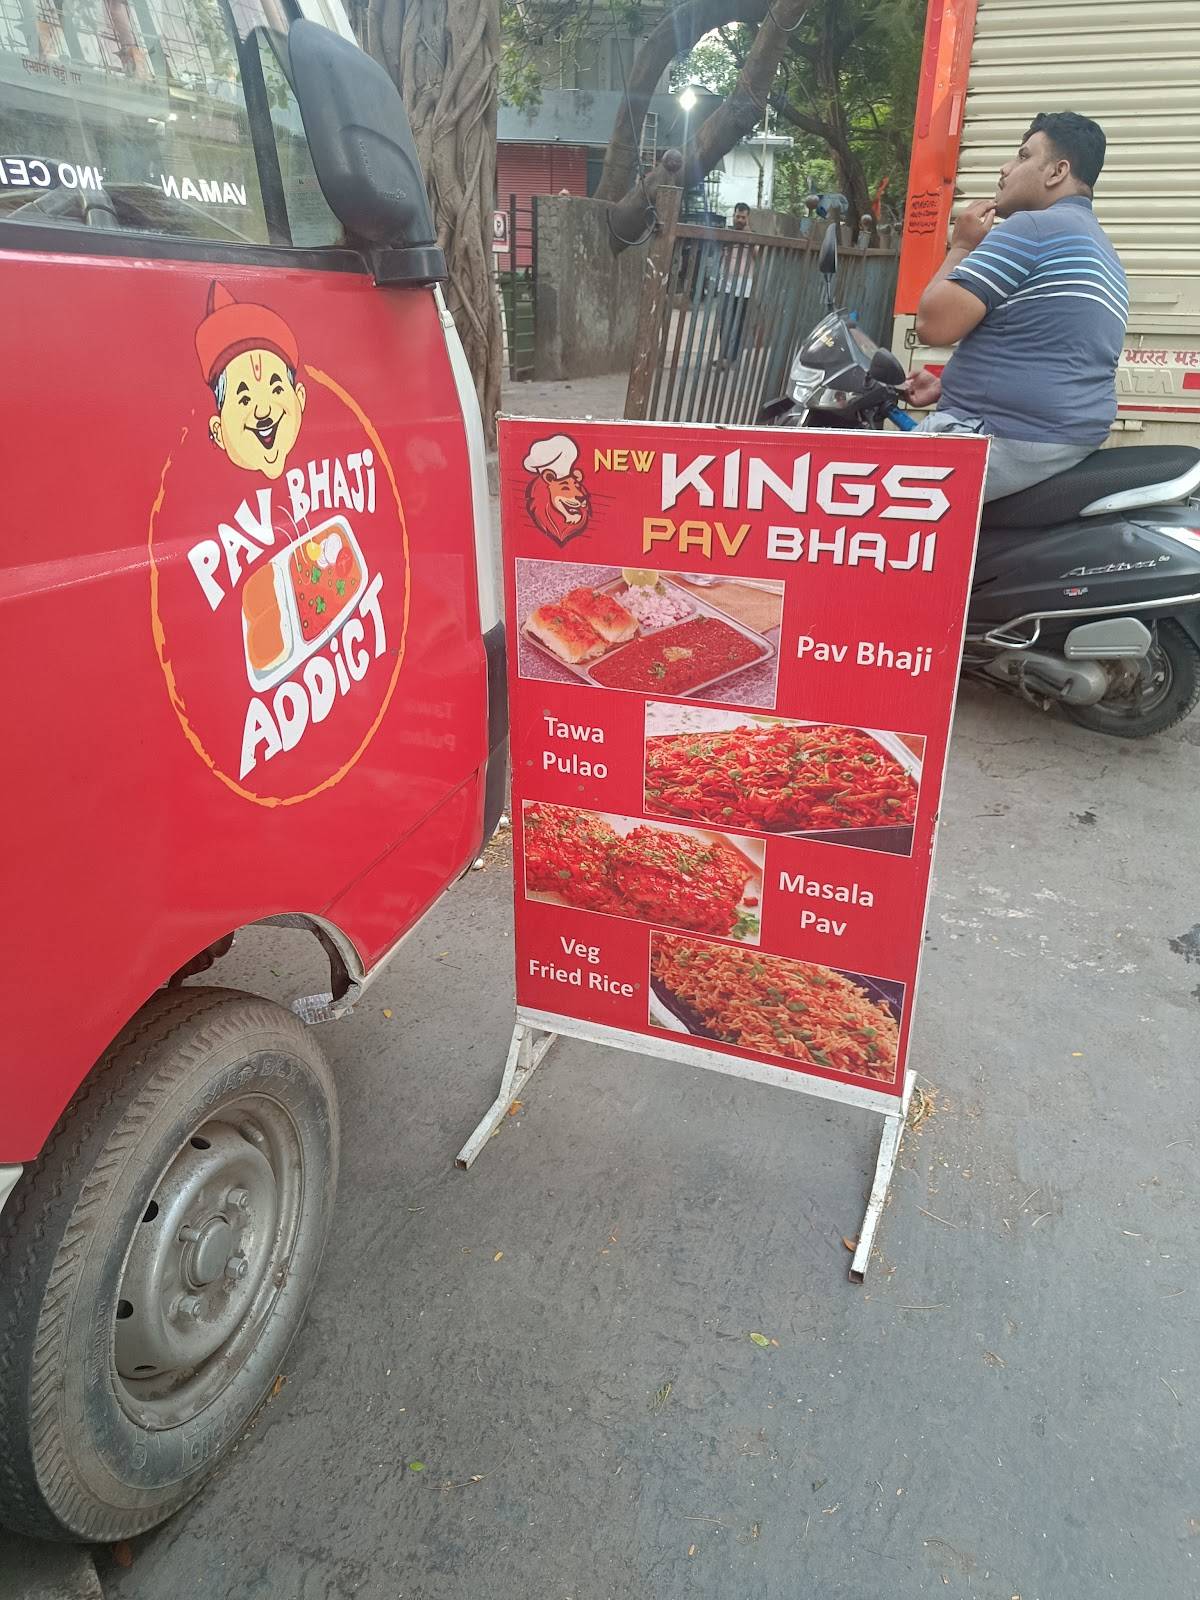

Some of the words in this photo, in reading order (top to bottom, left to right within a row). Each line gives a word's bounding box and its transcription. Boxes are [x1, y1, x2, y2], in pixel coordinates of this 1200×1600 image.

[1124, 349, 1168, 366] भारत
[1173, 351, 1200, 367] मह
[594, 449, 656, 473] NEW
[661, 448, 955, 523] KINGS
[187, 488, 275, 611] PAV
[642, 517, 750, 560] PAV
[766, 526, 937, 572] BHAJI
[797, 635, 848, 664] Pav
[857, 642, 933, 678] Bhaji
[543, 716, 605, 744] Tawa
[542, 751, 608, 780] Pulao
[778, 871, 875, 908] Masala
[800, 910, 848, 937] Pav
[560, 935, 601, 964] Veg
[528, 960, 583, 987] Fried
[588, 973, 634, 998] Rice
